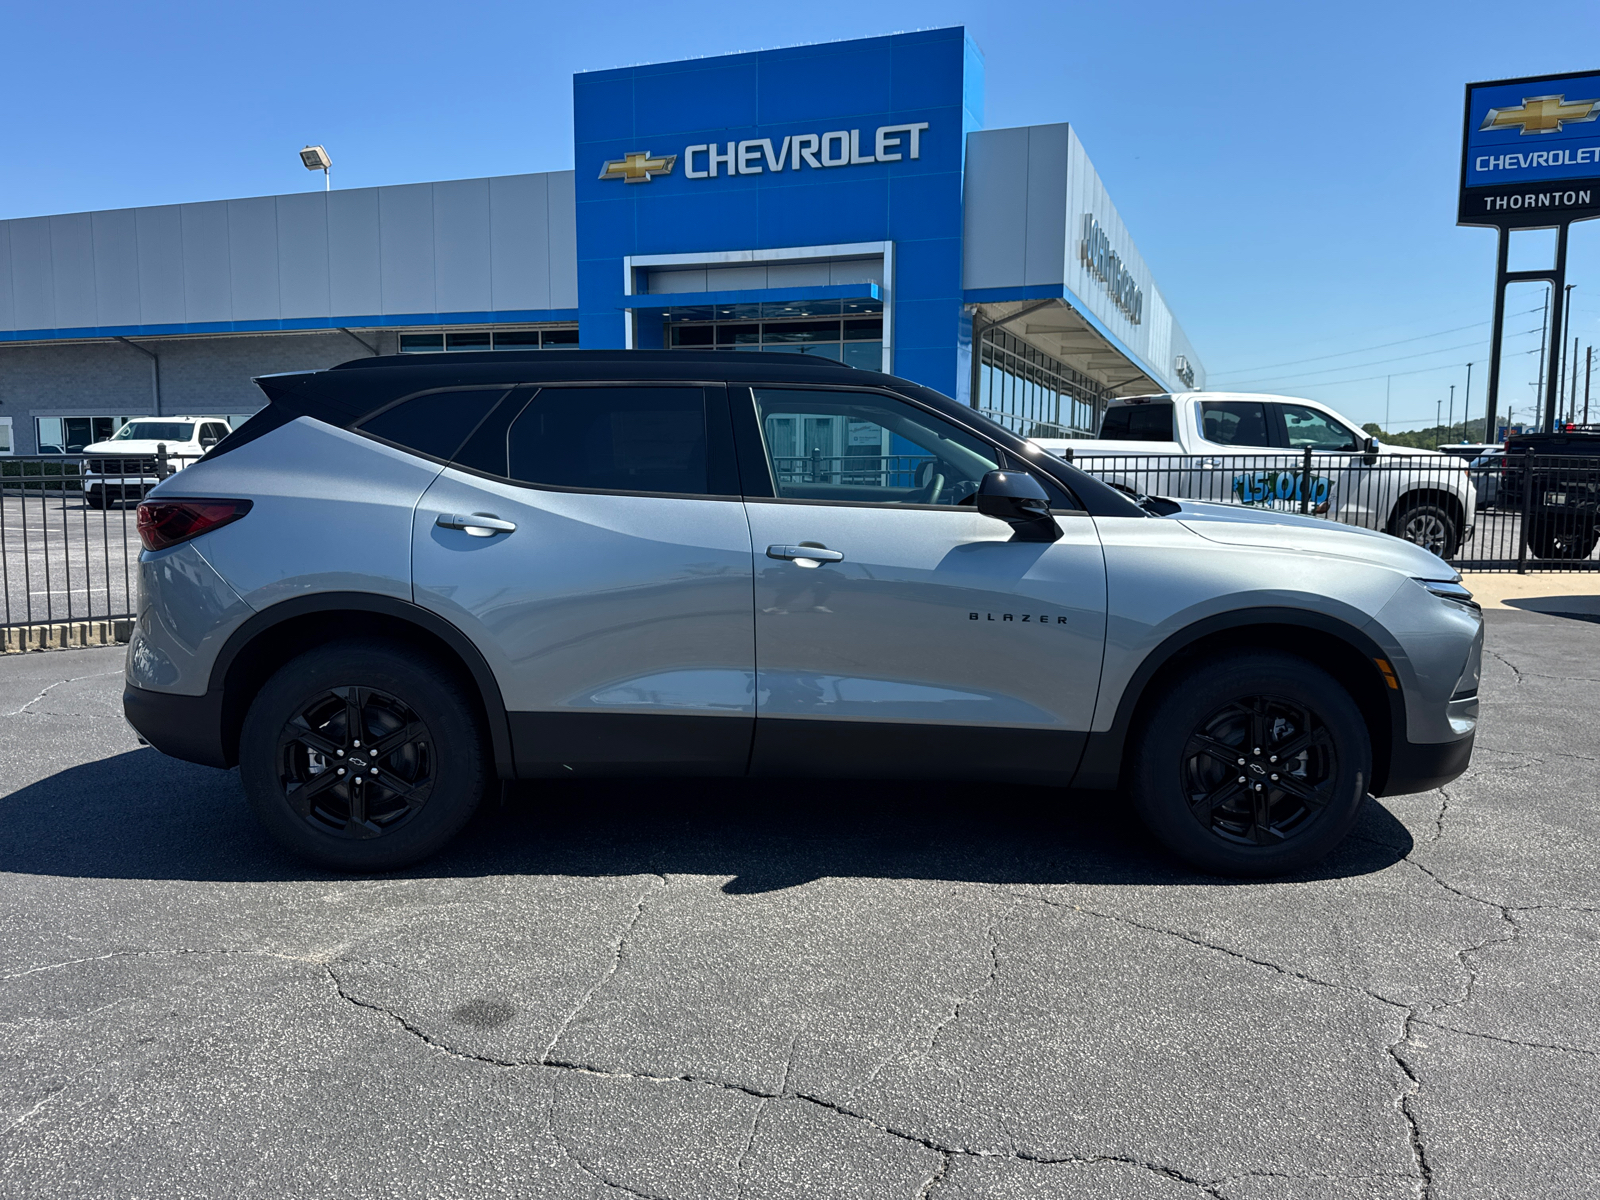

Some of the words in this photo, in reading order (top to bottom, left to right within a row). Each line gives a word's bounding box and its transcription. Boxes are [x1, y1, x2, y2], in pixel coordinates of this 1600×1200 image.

[684, 122, 929, 179] CHEVROLET
[1475, 147, 1600, 172] CHEVROLET
[1484, 190, 1591, 211] THORNTON
[968, 612, 1068, 625] BLAZER
